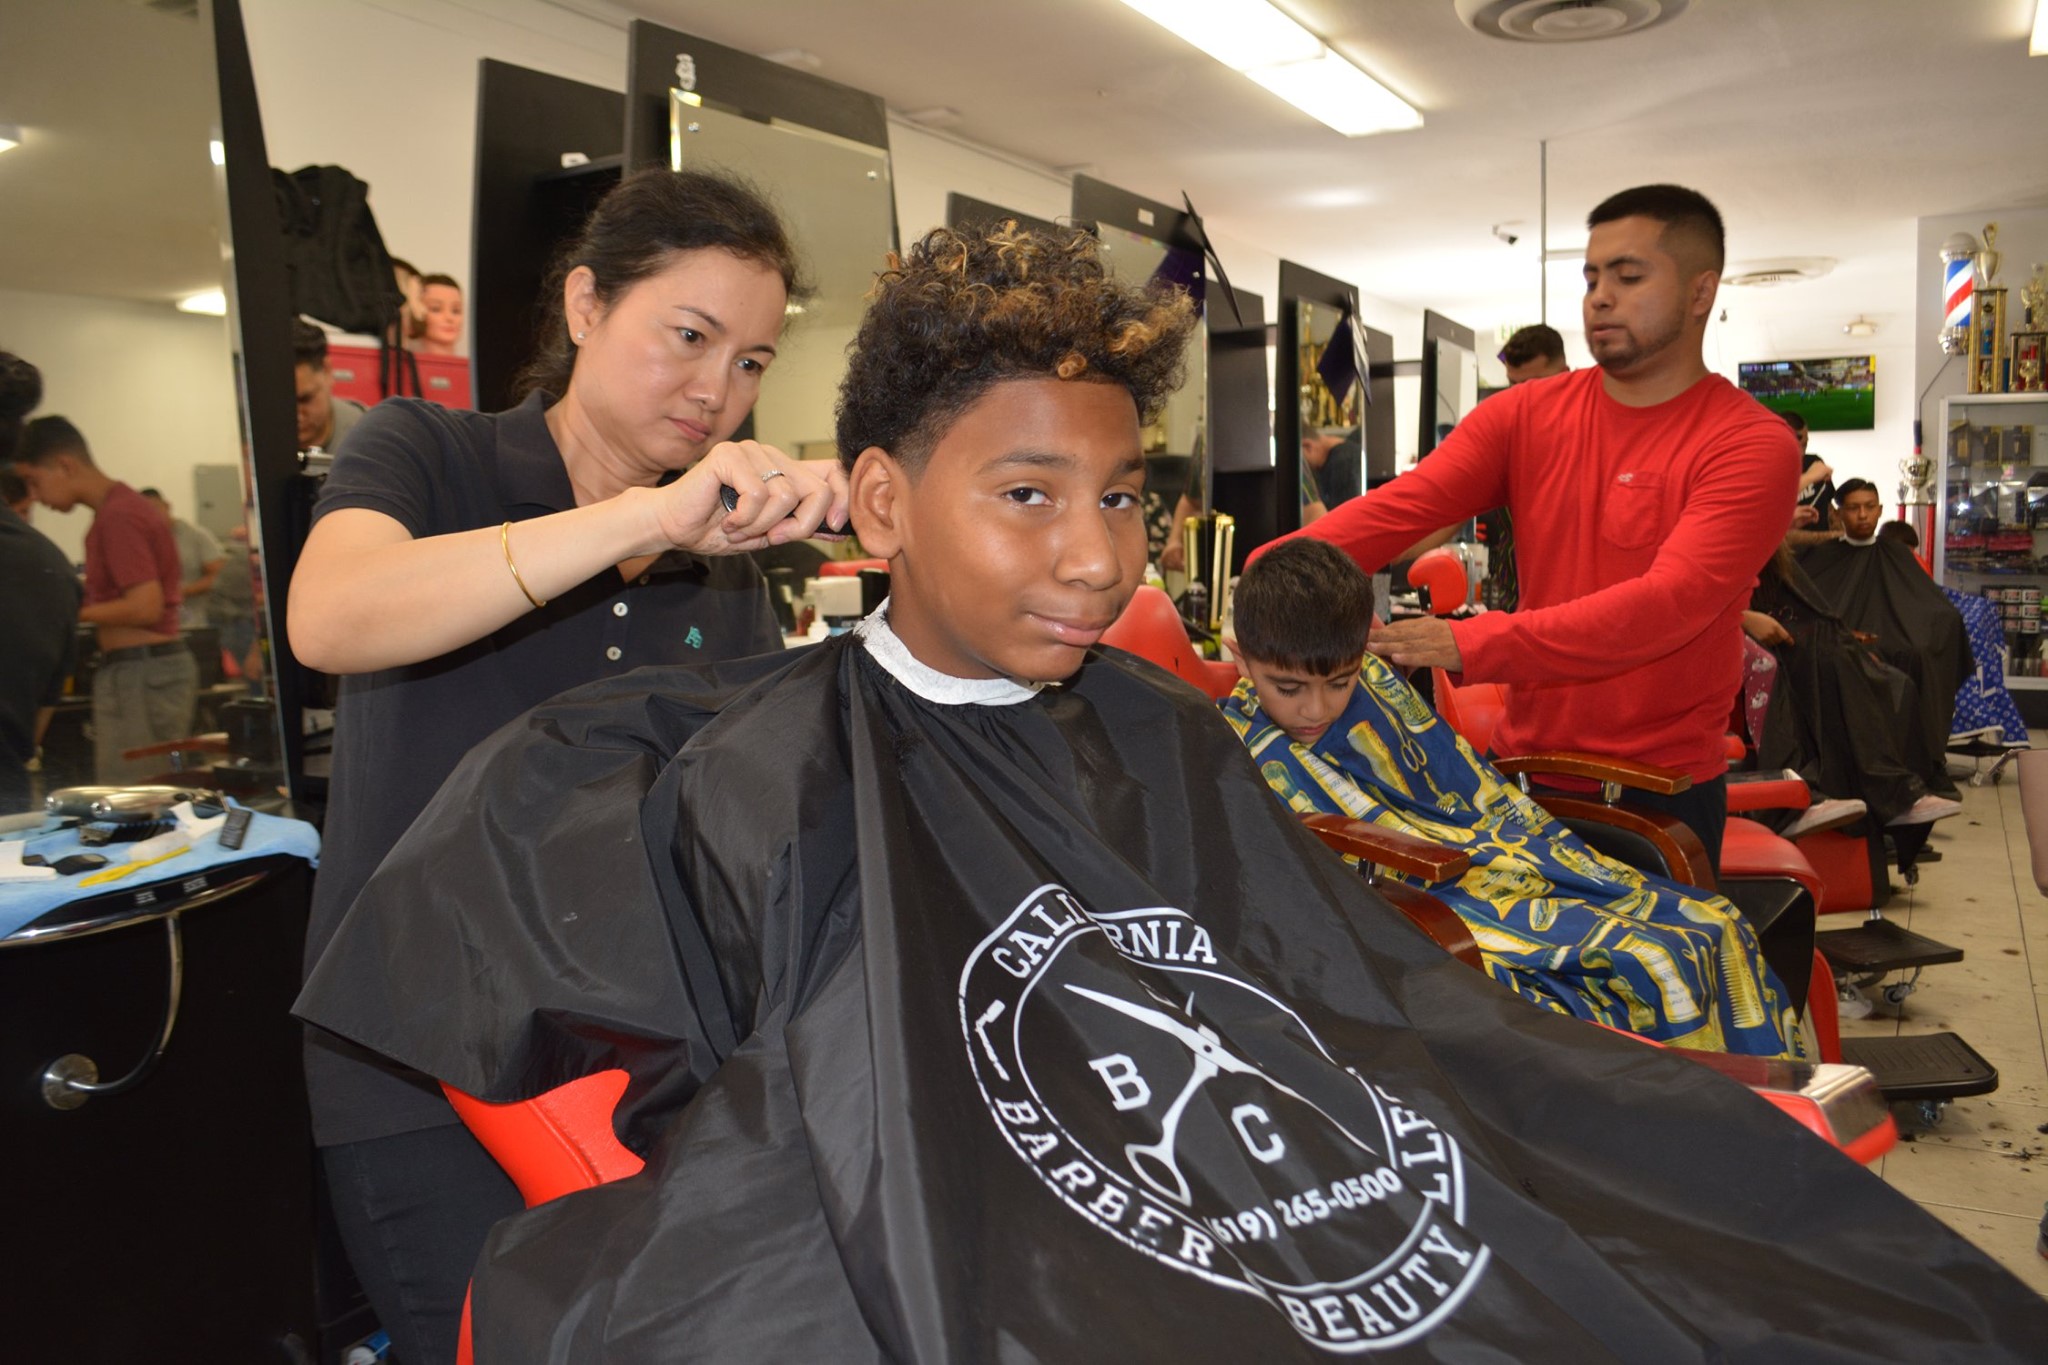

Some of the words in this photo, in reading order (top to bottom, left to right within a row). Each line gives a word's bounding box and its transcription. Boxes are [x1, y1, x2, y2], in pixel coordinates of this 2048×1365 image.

[1088, 1053, 1151, 1111] B
[1231, 1103, 1286, 1164] C
[995, 1097, 1214, 1267] BARBER
[1273, 1166, 1402, 1227] 265-0500
[1277, 1224, 1472, 1340] BEAUTY
